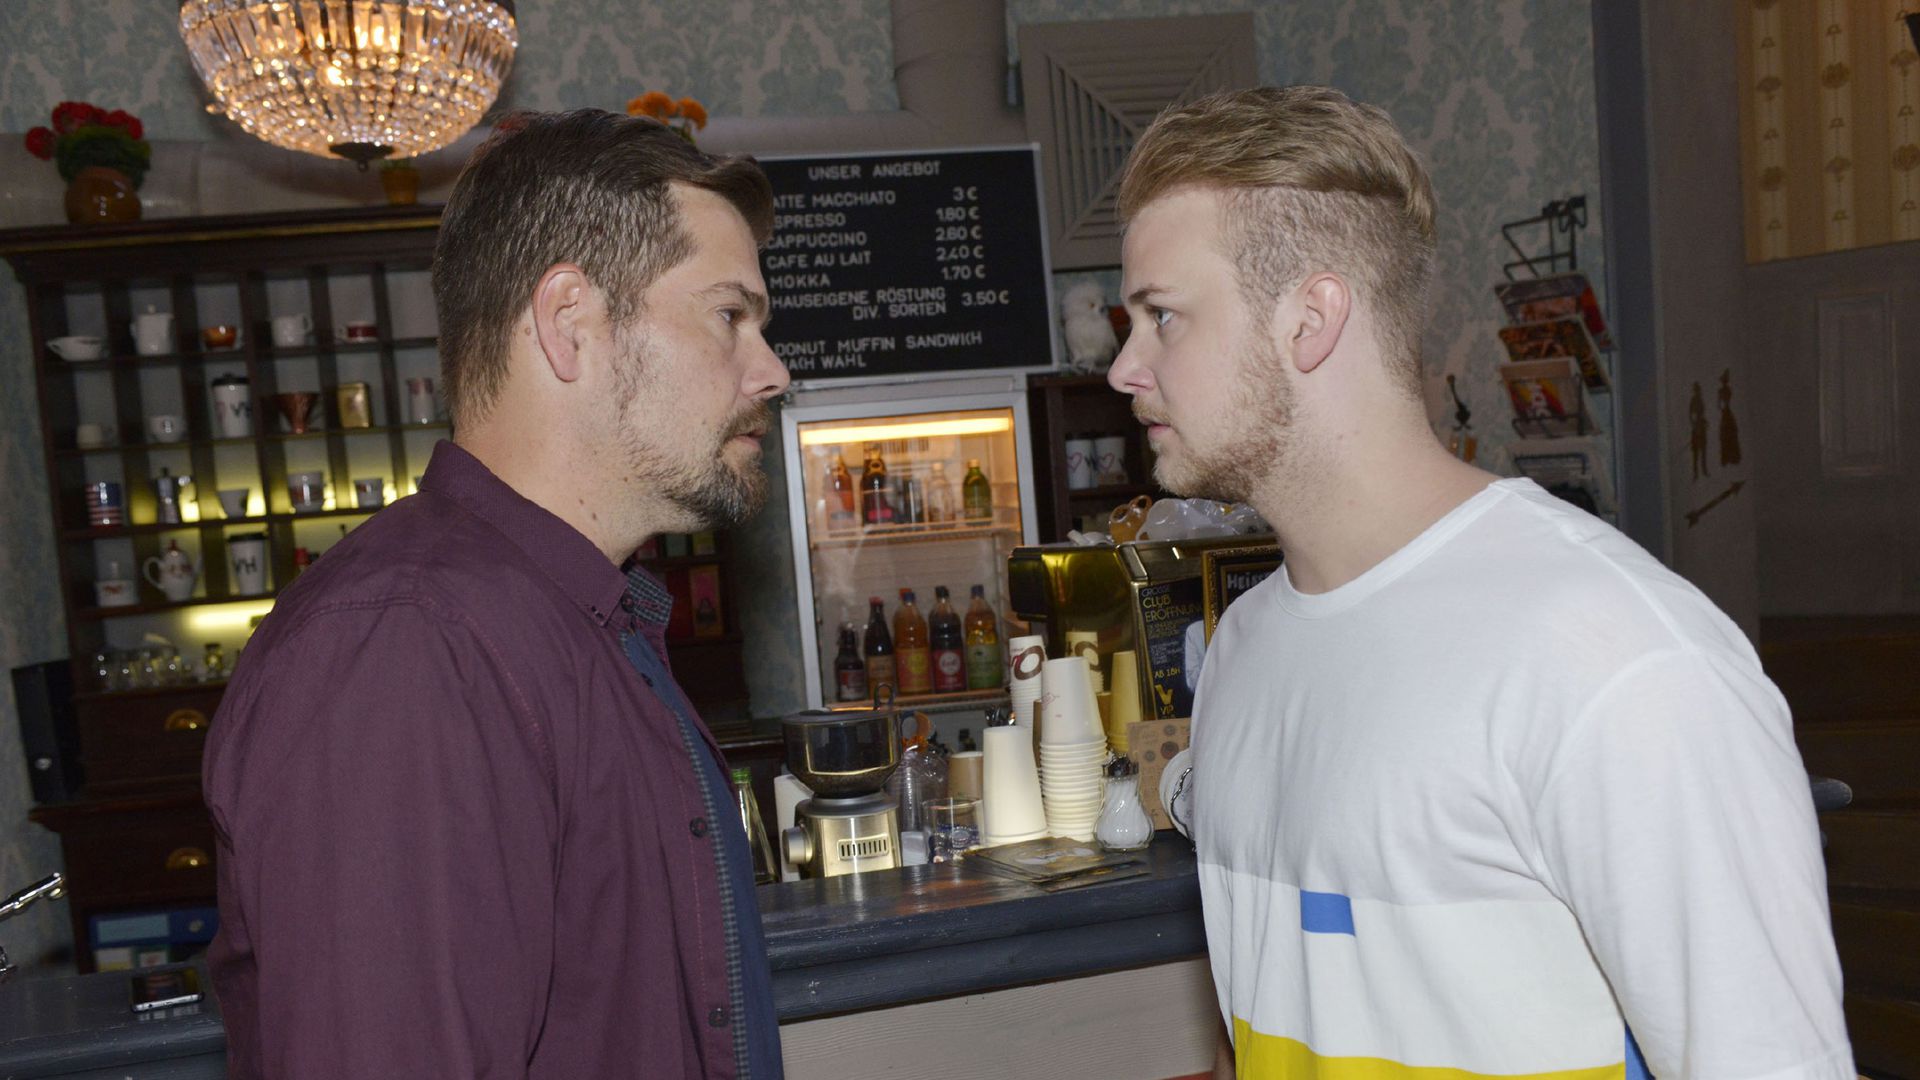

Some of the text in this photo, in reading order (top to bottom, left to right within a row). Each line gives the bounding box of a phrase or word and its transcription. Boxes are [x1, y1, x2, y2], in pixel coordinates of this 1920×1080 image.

[808, 161, 941, 180] UNSER ANGEBOT
[773, 194, 805, 209] ATTE
[812, 190, 896, 208] MACCHIATO
[953, 186, 964, 201] 3
[774, 212, 846, 230] SPRESSO
[766, 254, 808, 269] CAFE
[814, 253, 835, 267] AU
[840, 251, 871, 266] LAIT
[770, 273, 830, 289] MOKKA
[771, 290, 869, 309] HAUSEIGENE
[876, 286, 946, 303] RÖSTUNG
[962, 290, 997, 306] 3.50
[888, 302, 946, 318] SORTEN
[775, 340, 826, 357] DONUT
[837, 337, 896, 354] MUFFIN
[820, 353, 866, 369] WAHL
[1142, 594, 1171, 609] CLUB
